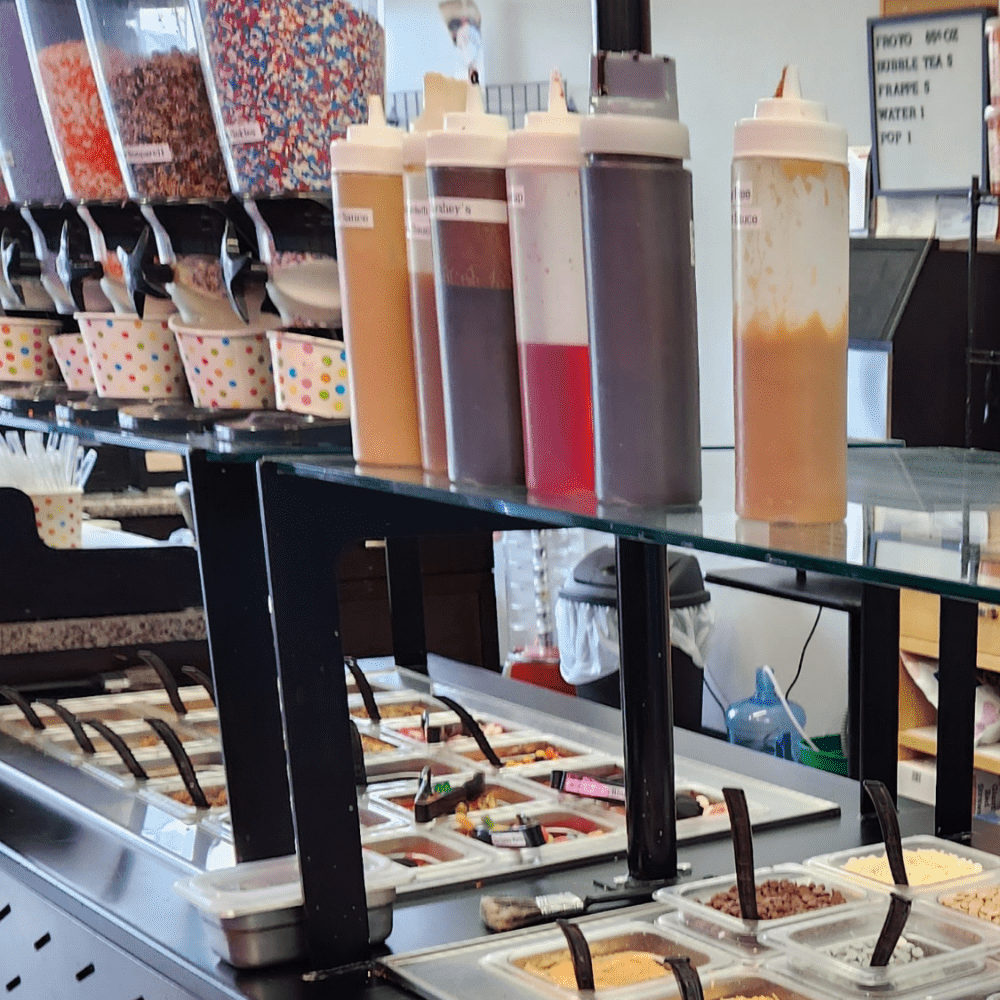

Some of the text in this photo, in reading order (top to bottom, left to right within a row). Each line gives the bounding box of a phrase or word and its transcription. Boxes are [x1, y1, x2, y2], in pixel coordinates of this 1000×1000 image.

[876, 32, 912, 50] FROYO
[923, 54, 942, 70] TEA
[879, 81, 919, 97] FRAPPE
[879, 106, 916, 121] WATER
[881, 130, 902, 144] POP
